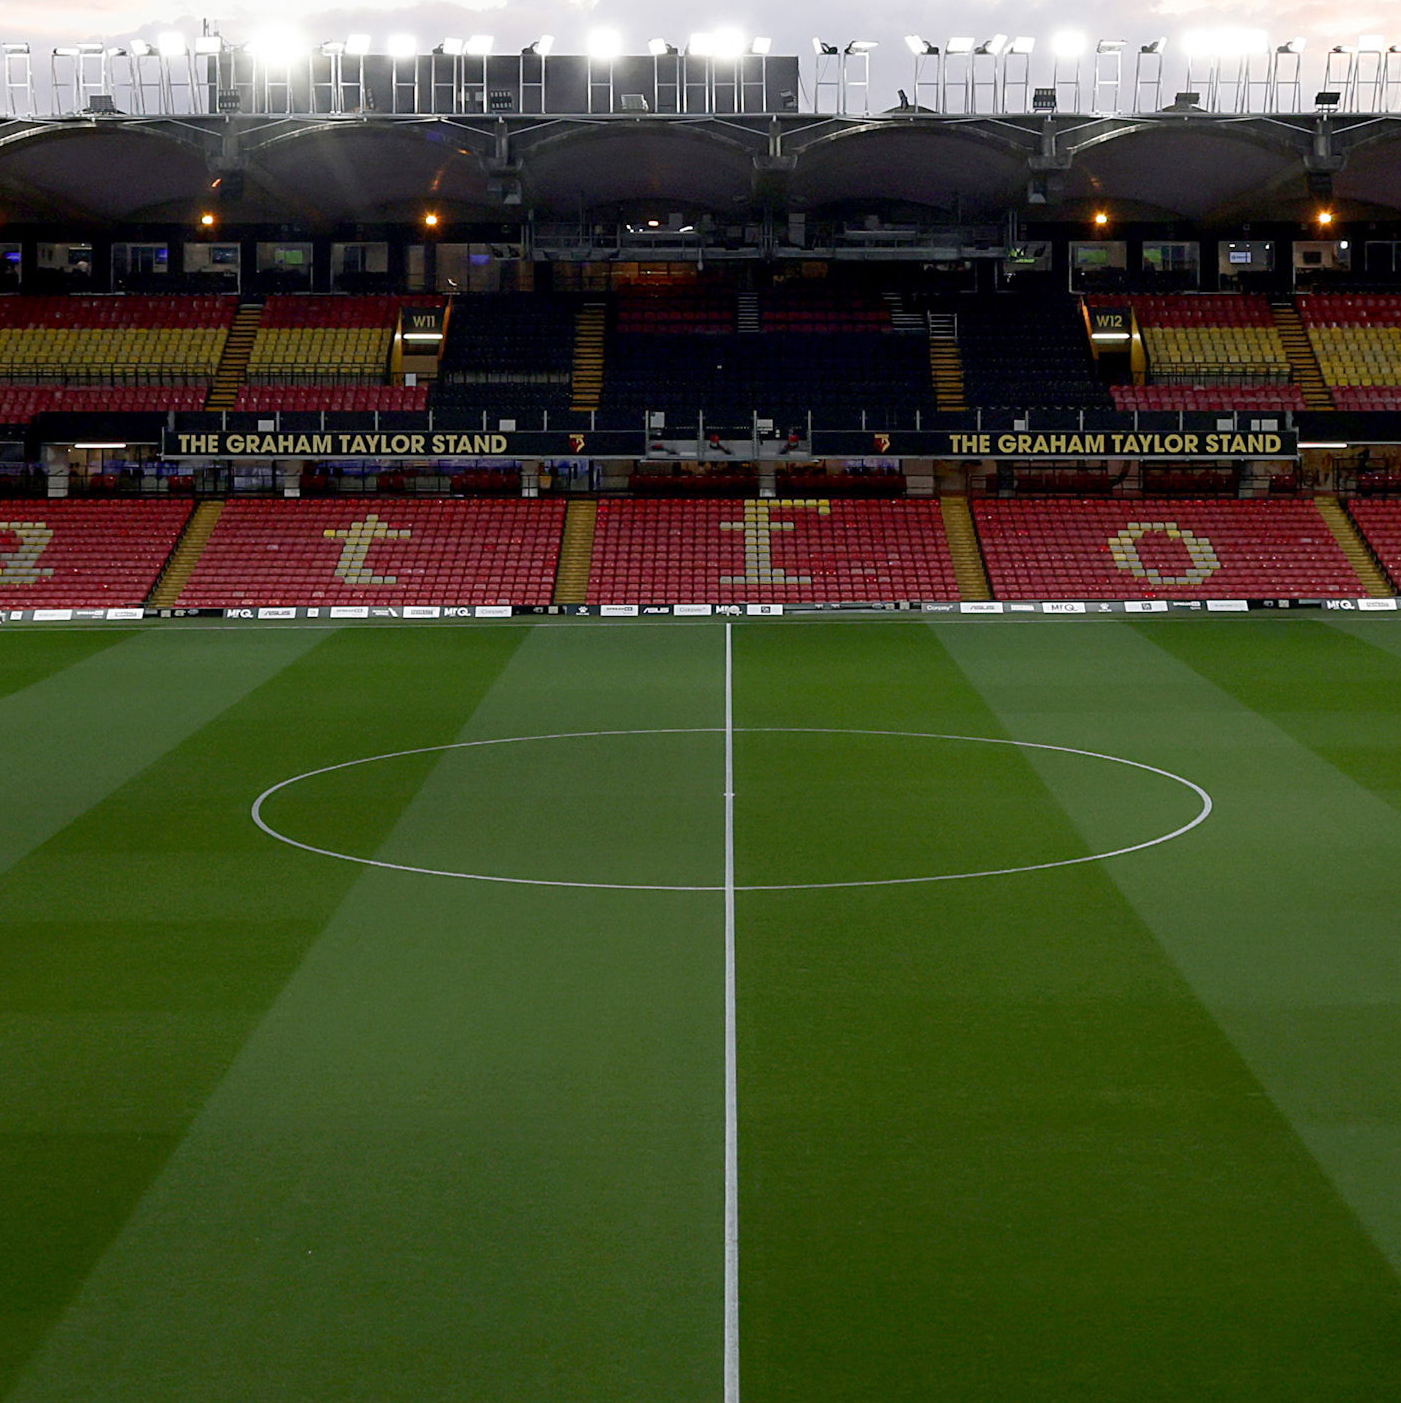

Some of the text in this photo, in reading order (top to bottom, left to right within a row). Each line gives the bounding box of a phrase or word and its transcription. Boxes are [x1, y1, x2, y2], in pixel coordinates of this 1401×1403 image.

[412, 315, 436, 328] W11
[1095, 314, 1123, 328] W12
[177, 433, 508, 454] THE GRAHAM TAYLOR STAND
[949, 433, 1282, 454] THE GRAHAM TAYLOR STAND
